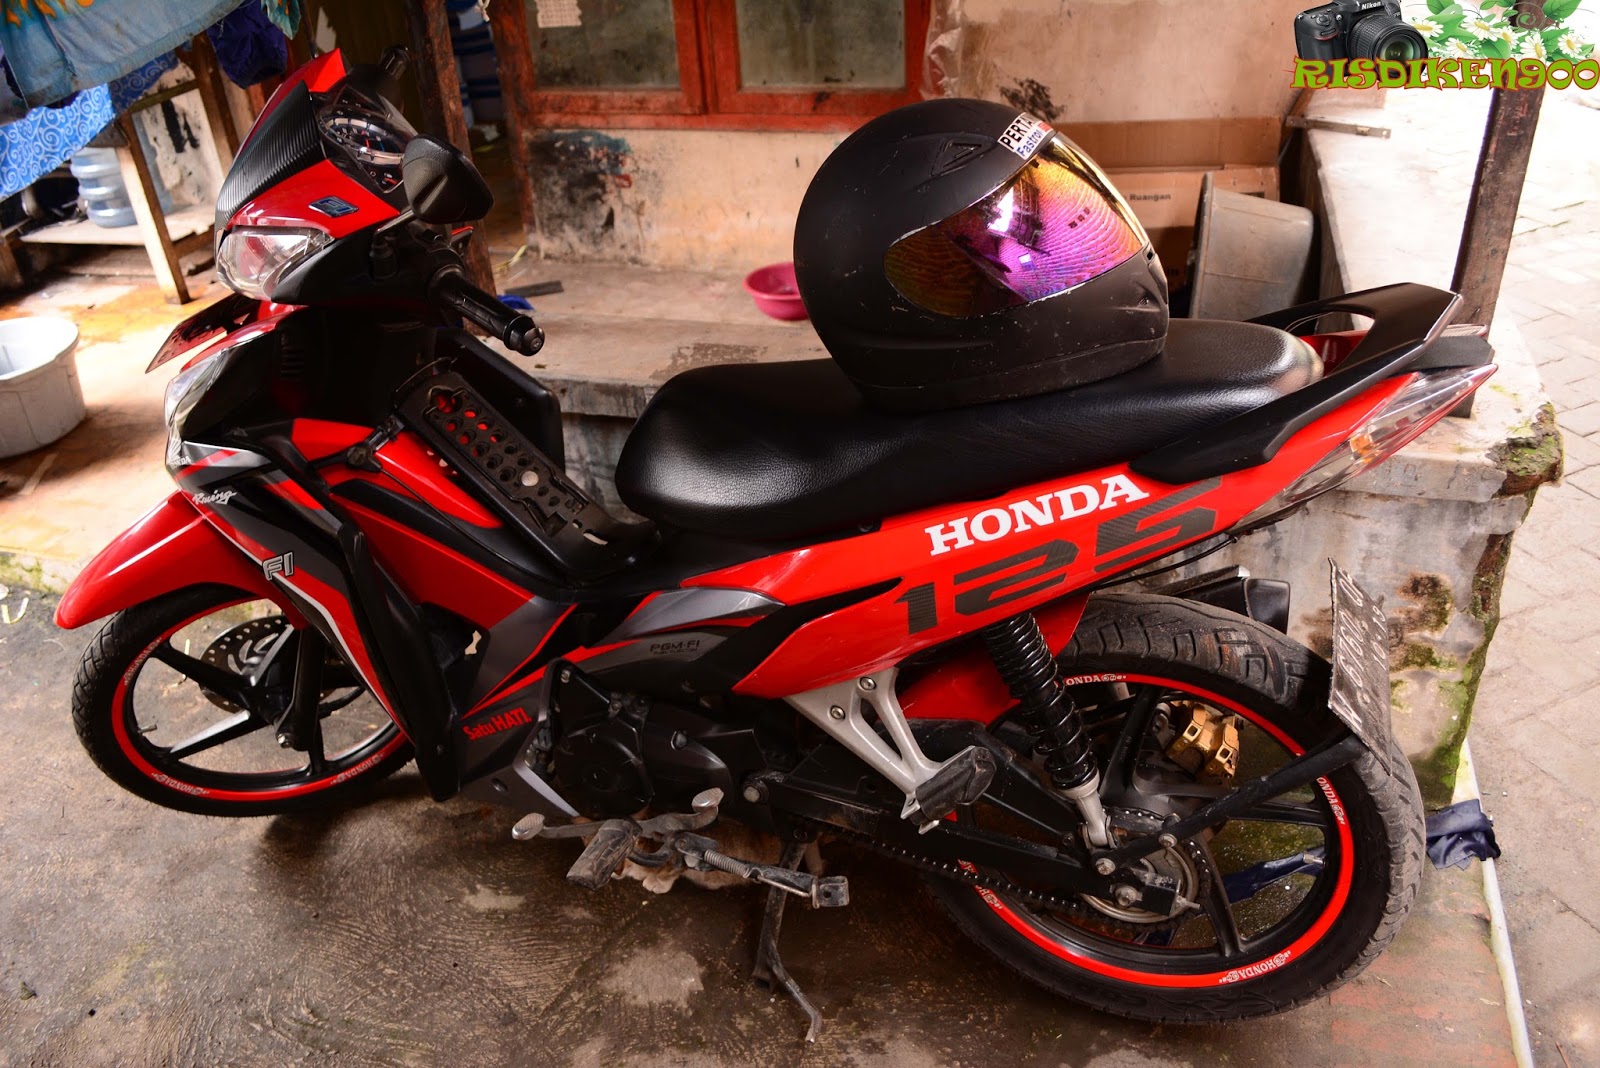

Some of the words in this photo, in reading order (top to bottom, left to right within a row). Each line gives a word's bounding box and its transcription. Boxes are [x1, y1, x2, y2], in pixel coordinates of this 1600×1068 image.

[1129, 193, 1171, 202] Ruangan
[924, 473, 1150, 556] HONDA
[262, 551, 294, 581] FI
[893, 475, 1223, 635] 125
[1337, 609, 1364, 688] 6760
[1063, 674, 1102, 686] ONDA
[462, 723, 497, 741] Satu
[1315, 776, 1339, 806] ONDA
[1238, 959, 1277, 979] HONDA
